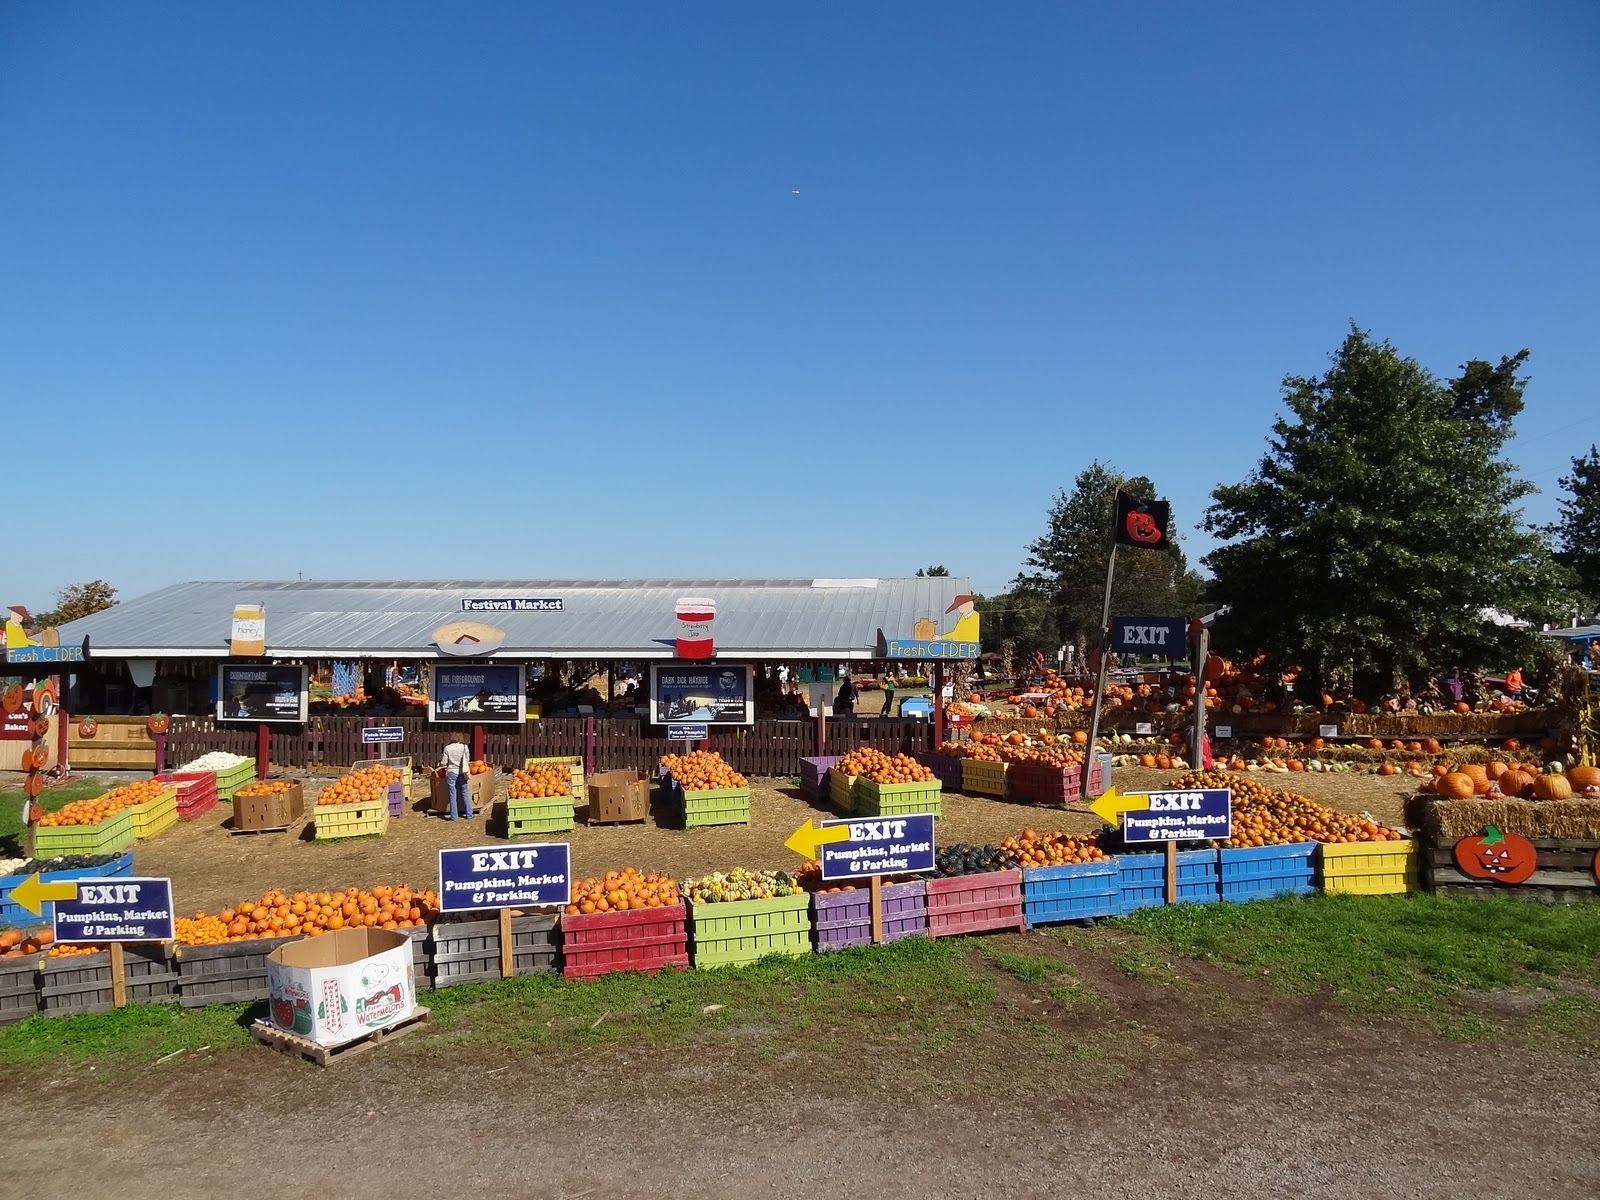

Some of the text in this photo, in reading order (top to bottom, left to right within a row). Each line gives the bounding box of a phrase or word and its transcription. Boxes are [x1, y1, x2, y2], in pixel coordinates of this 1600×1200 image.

[463, 599, 562, 610] Festival Market
[237, 624, 260, 637] Honey
[1123, 626, 1169, 644] EXIT
[8, 647, 84, 662] Fresh CIDER
[890, 642, 977, 657] Fresh CIDER
[661, 676, 675, 684] DARK
[1149, 793, 1204, 811] EXIT
[1127, 814, 1227, 828] Pumpkins, Market
[849, 820, 907, 842] EXIT
[1149, 828, 1205, 839] & Parking
[825, 842, 930, 860] Pumpkins, Market
[471, 850, 538, 872] EXIT
[850, 858, 908, 871] & Parking
[445, 874, 565, 891] Pumpkins, Market
[80, 885, 141, 904] EXIT
[472, 890, 539, 903] & Parking
[57, 910, 168, 923] Pumpkins, Market
[83, 925, 145, 936] & Parking
[327, 985, 335, 1008] WATCH
